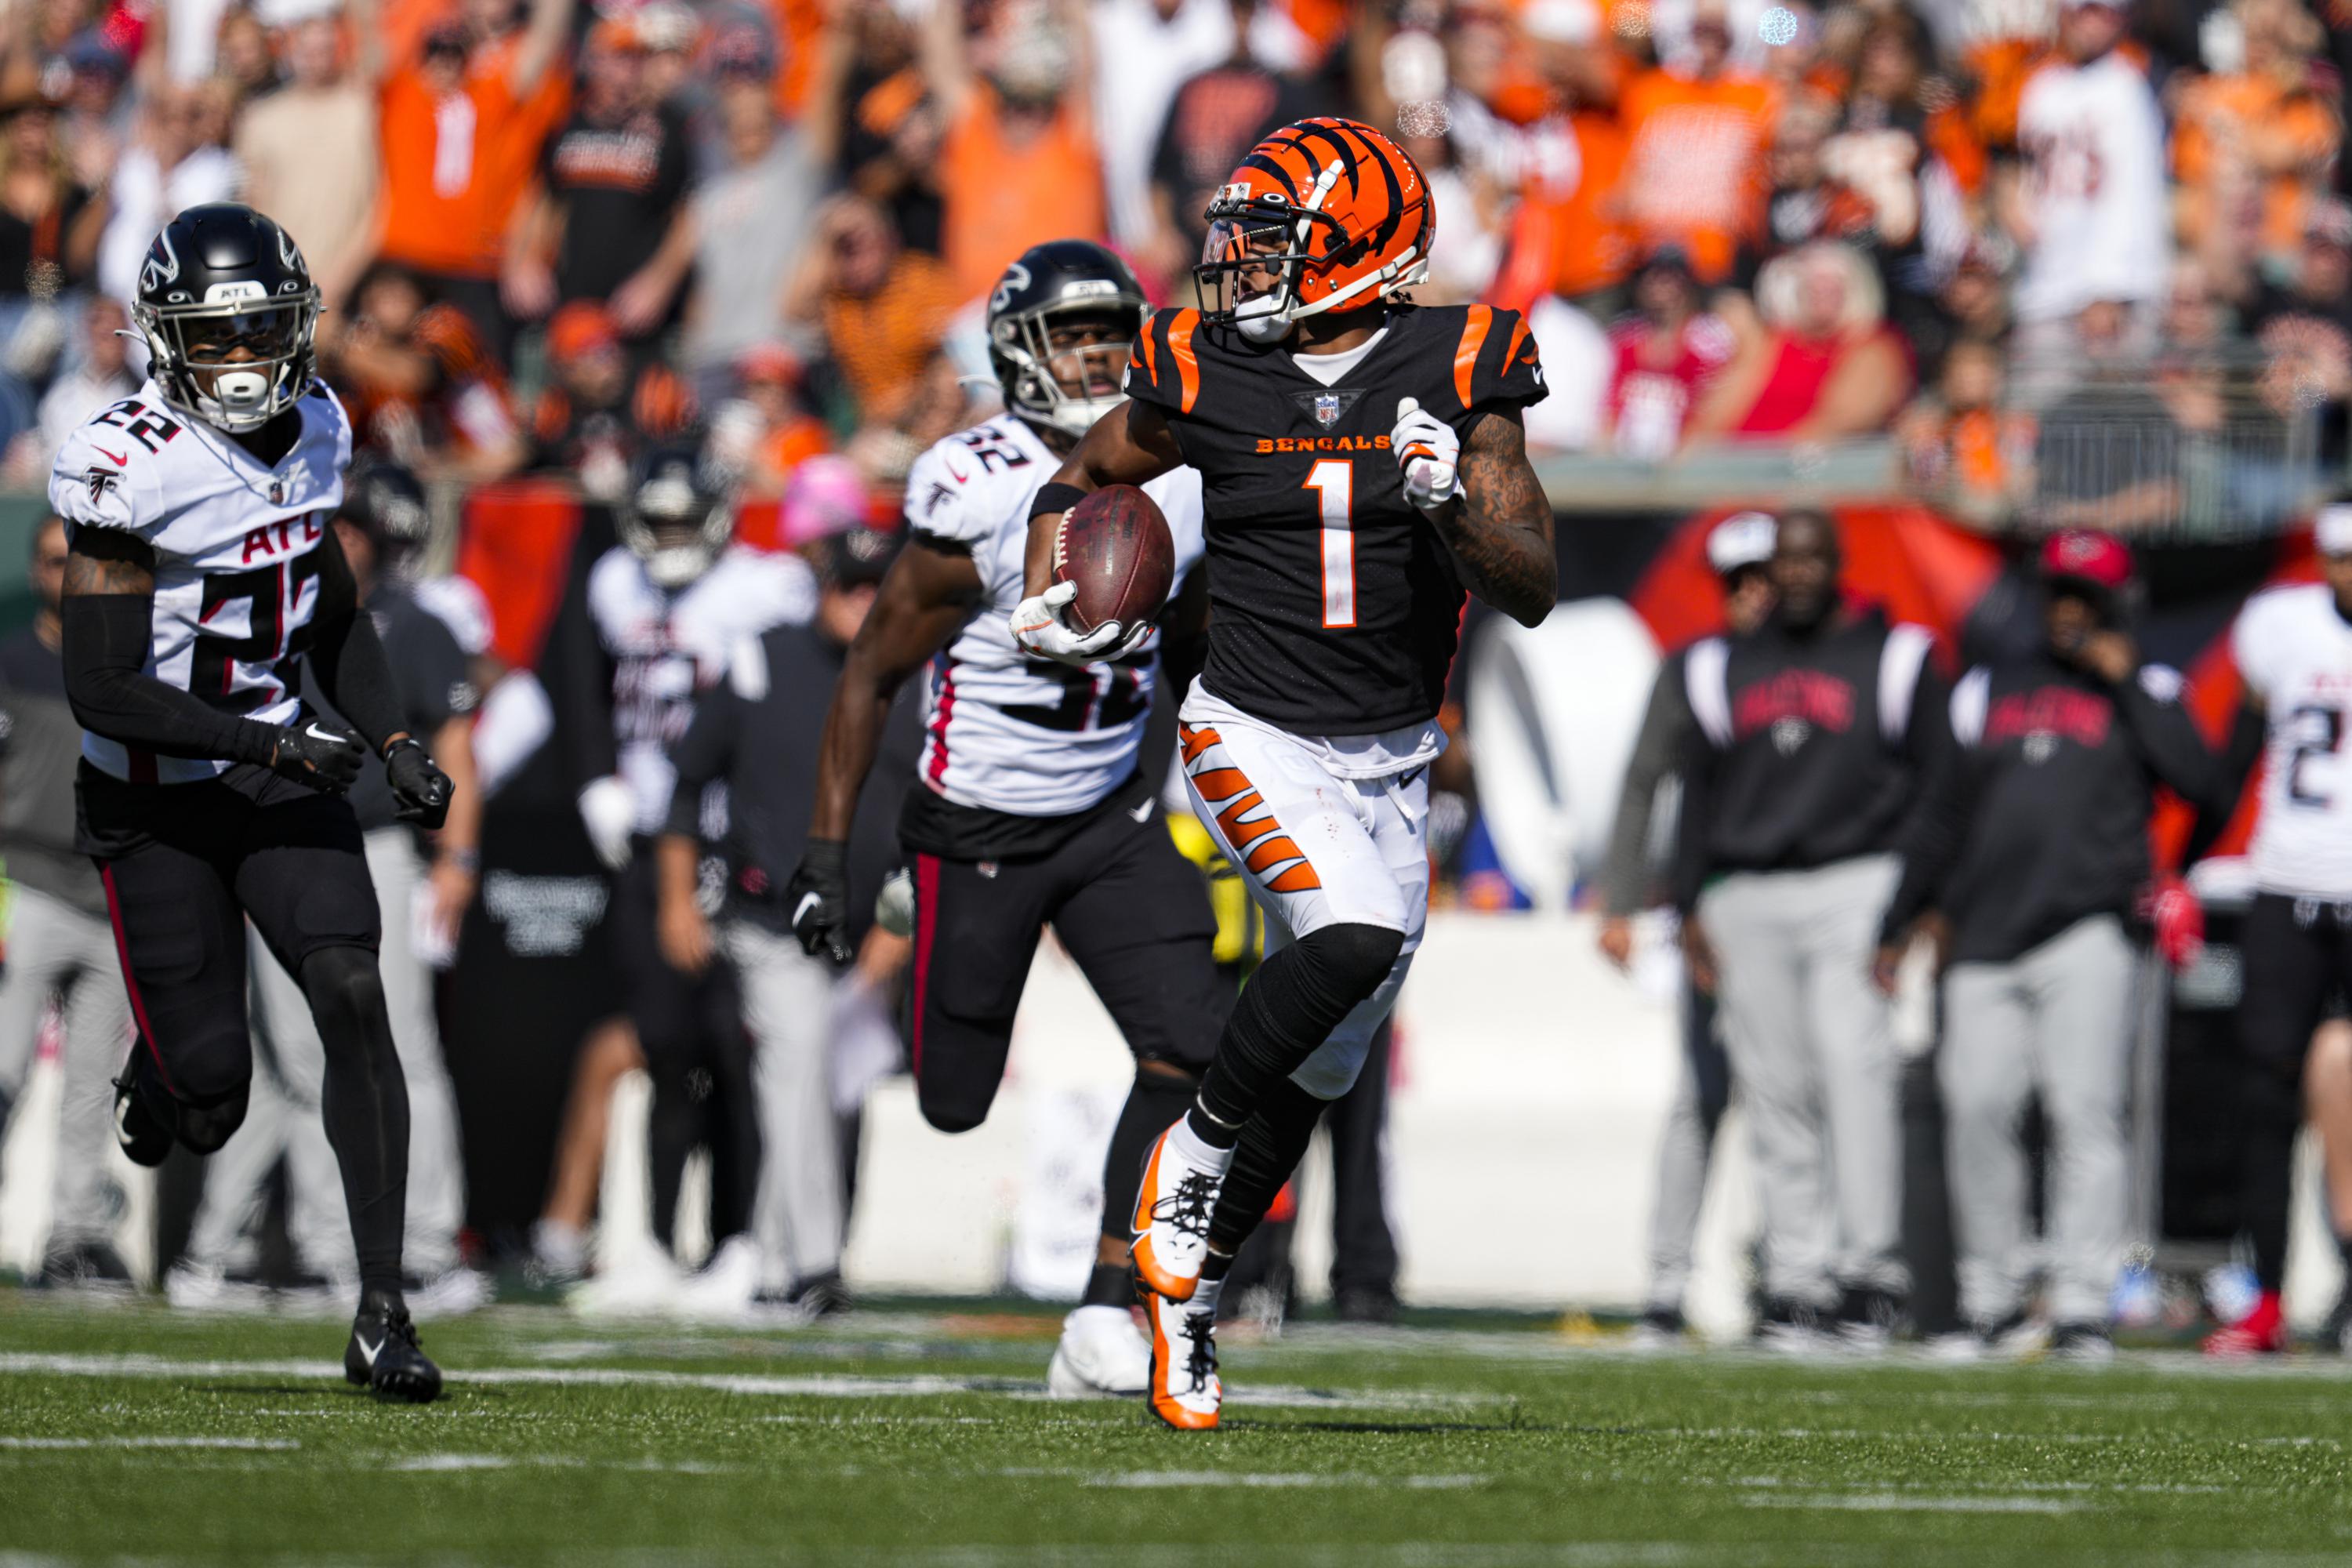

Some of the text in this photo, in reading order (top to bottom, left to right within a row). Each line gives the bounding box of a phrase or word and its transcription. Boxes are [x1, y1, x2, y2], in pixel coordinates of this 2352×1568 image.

[221, 285, 252, 299] ATL
[89, 400, 182, 455] 22
[1319, 408, 1338, 420] NFL
[1256, 435, 1391, 455] BENGALS
[242, 511, 321, 564] ATL
[1301, 458, 1357, 628] 1
